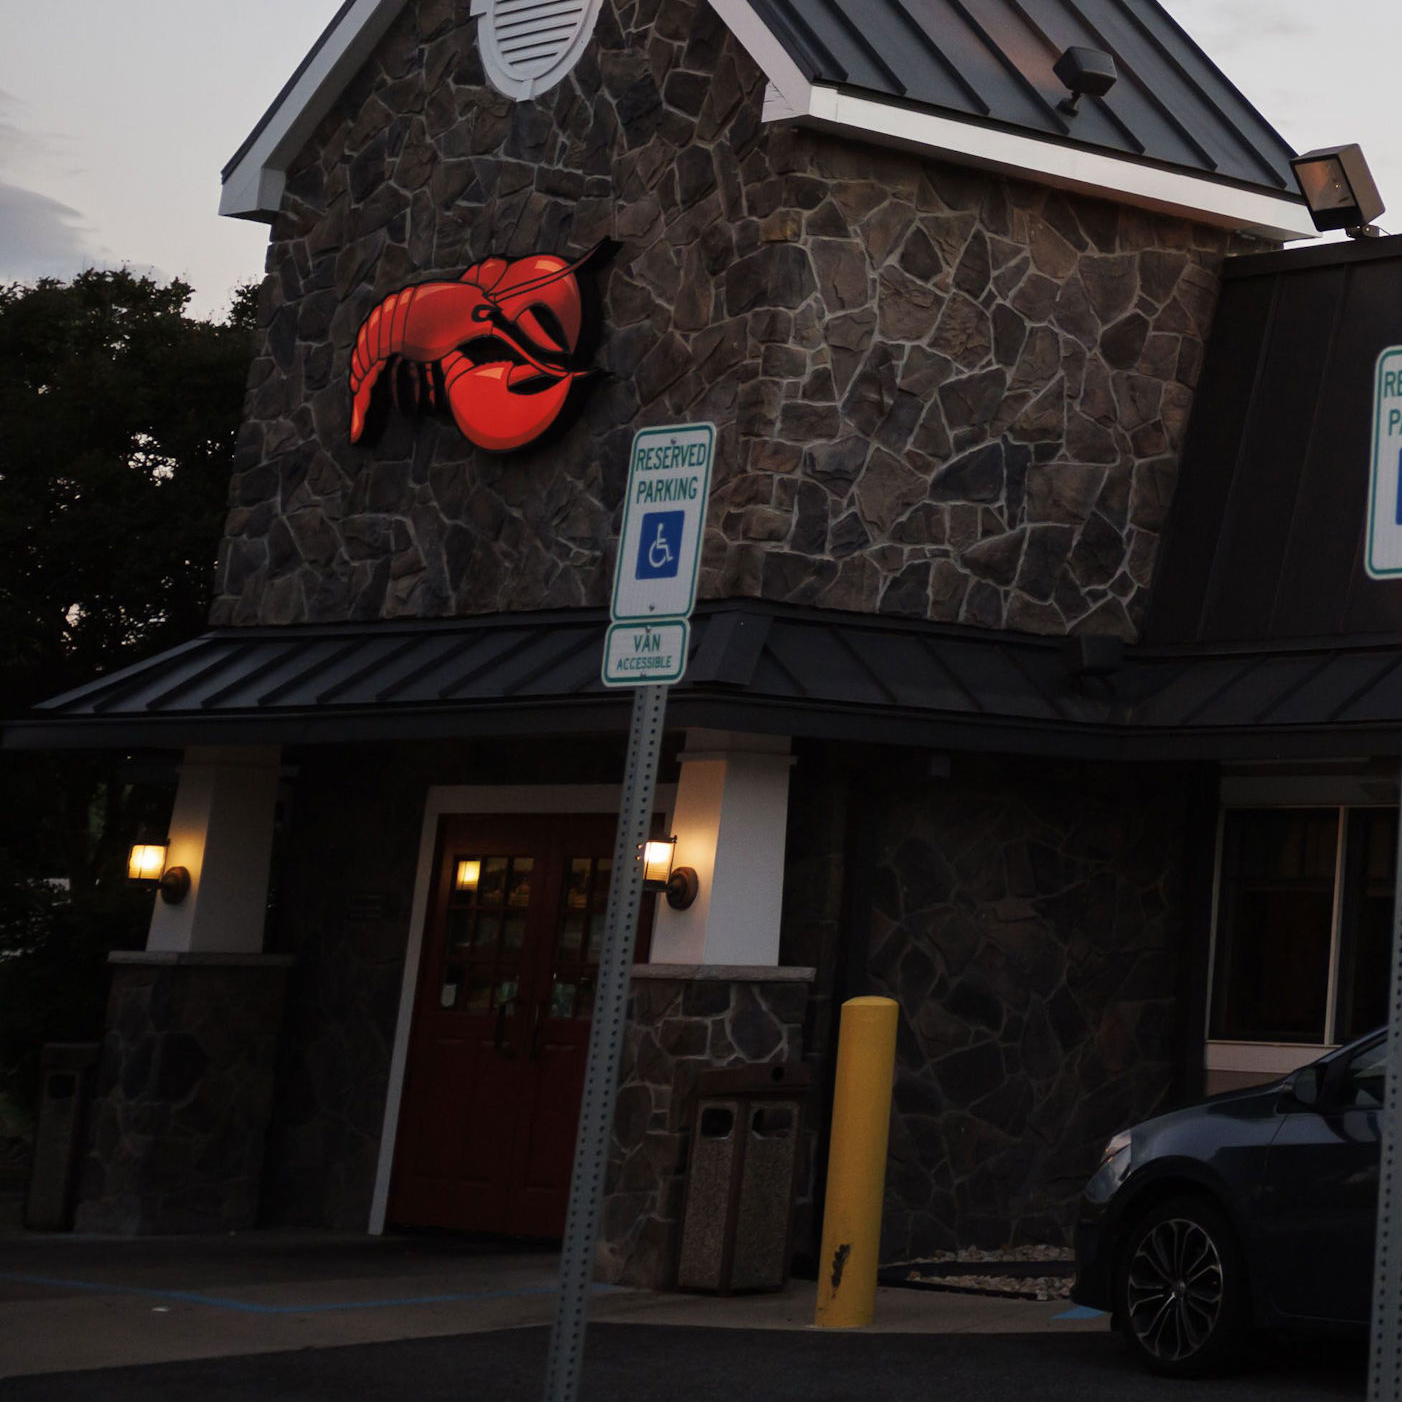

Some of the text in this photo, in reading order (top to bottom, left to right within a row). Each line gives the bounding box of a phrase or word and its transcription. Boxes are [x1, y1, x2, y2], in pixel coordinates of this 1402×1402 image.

[635, 442, 707, 472] RESERVED
[636, 476, 699, 504] PARKING
[634, 634, 661, 653] VAN
[616, 655, 673, 671] ACCESSIBLE
